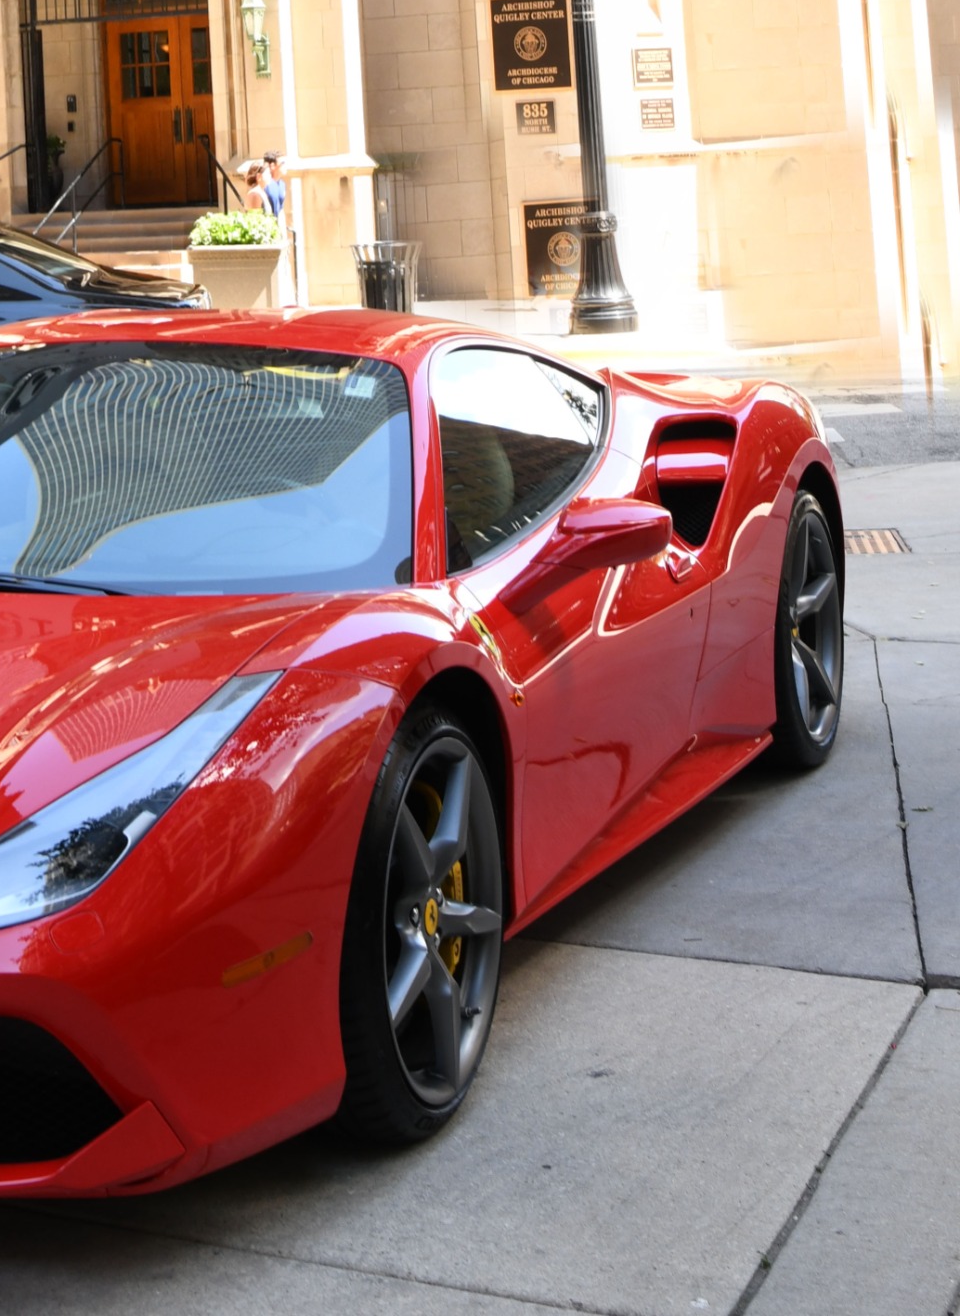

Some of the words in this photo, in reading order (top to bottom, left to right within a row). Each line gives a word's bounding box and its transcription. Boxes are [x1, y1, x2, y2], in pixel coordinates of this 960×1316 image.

[501, 0, 555, 12] ARCHBISHOP
[493, 12, 530, 24] QUIGLEY
[531, 10, 565, 20] CENTER
[507, 67, 558, 77] ARCHDIOCESE
[511, 77, 522, 85] OF
[522, 76, 555, 85] CHICAGO
[523, 103, 548, 118] 835
[524, 118, 548, 126] NORTH
[527, 218, 563, 229] QUIGLEY
